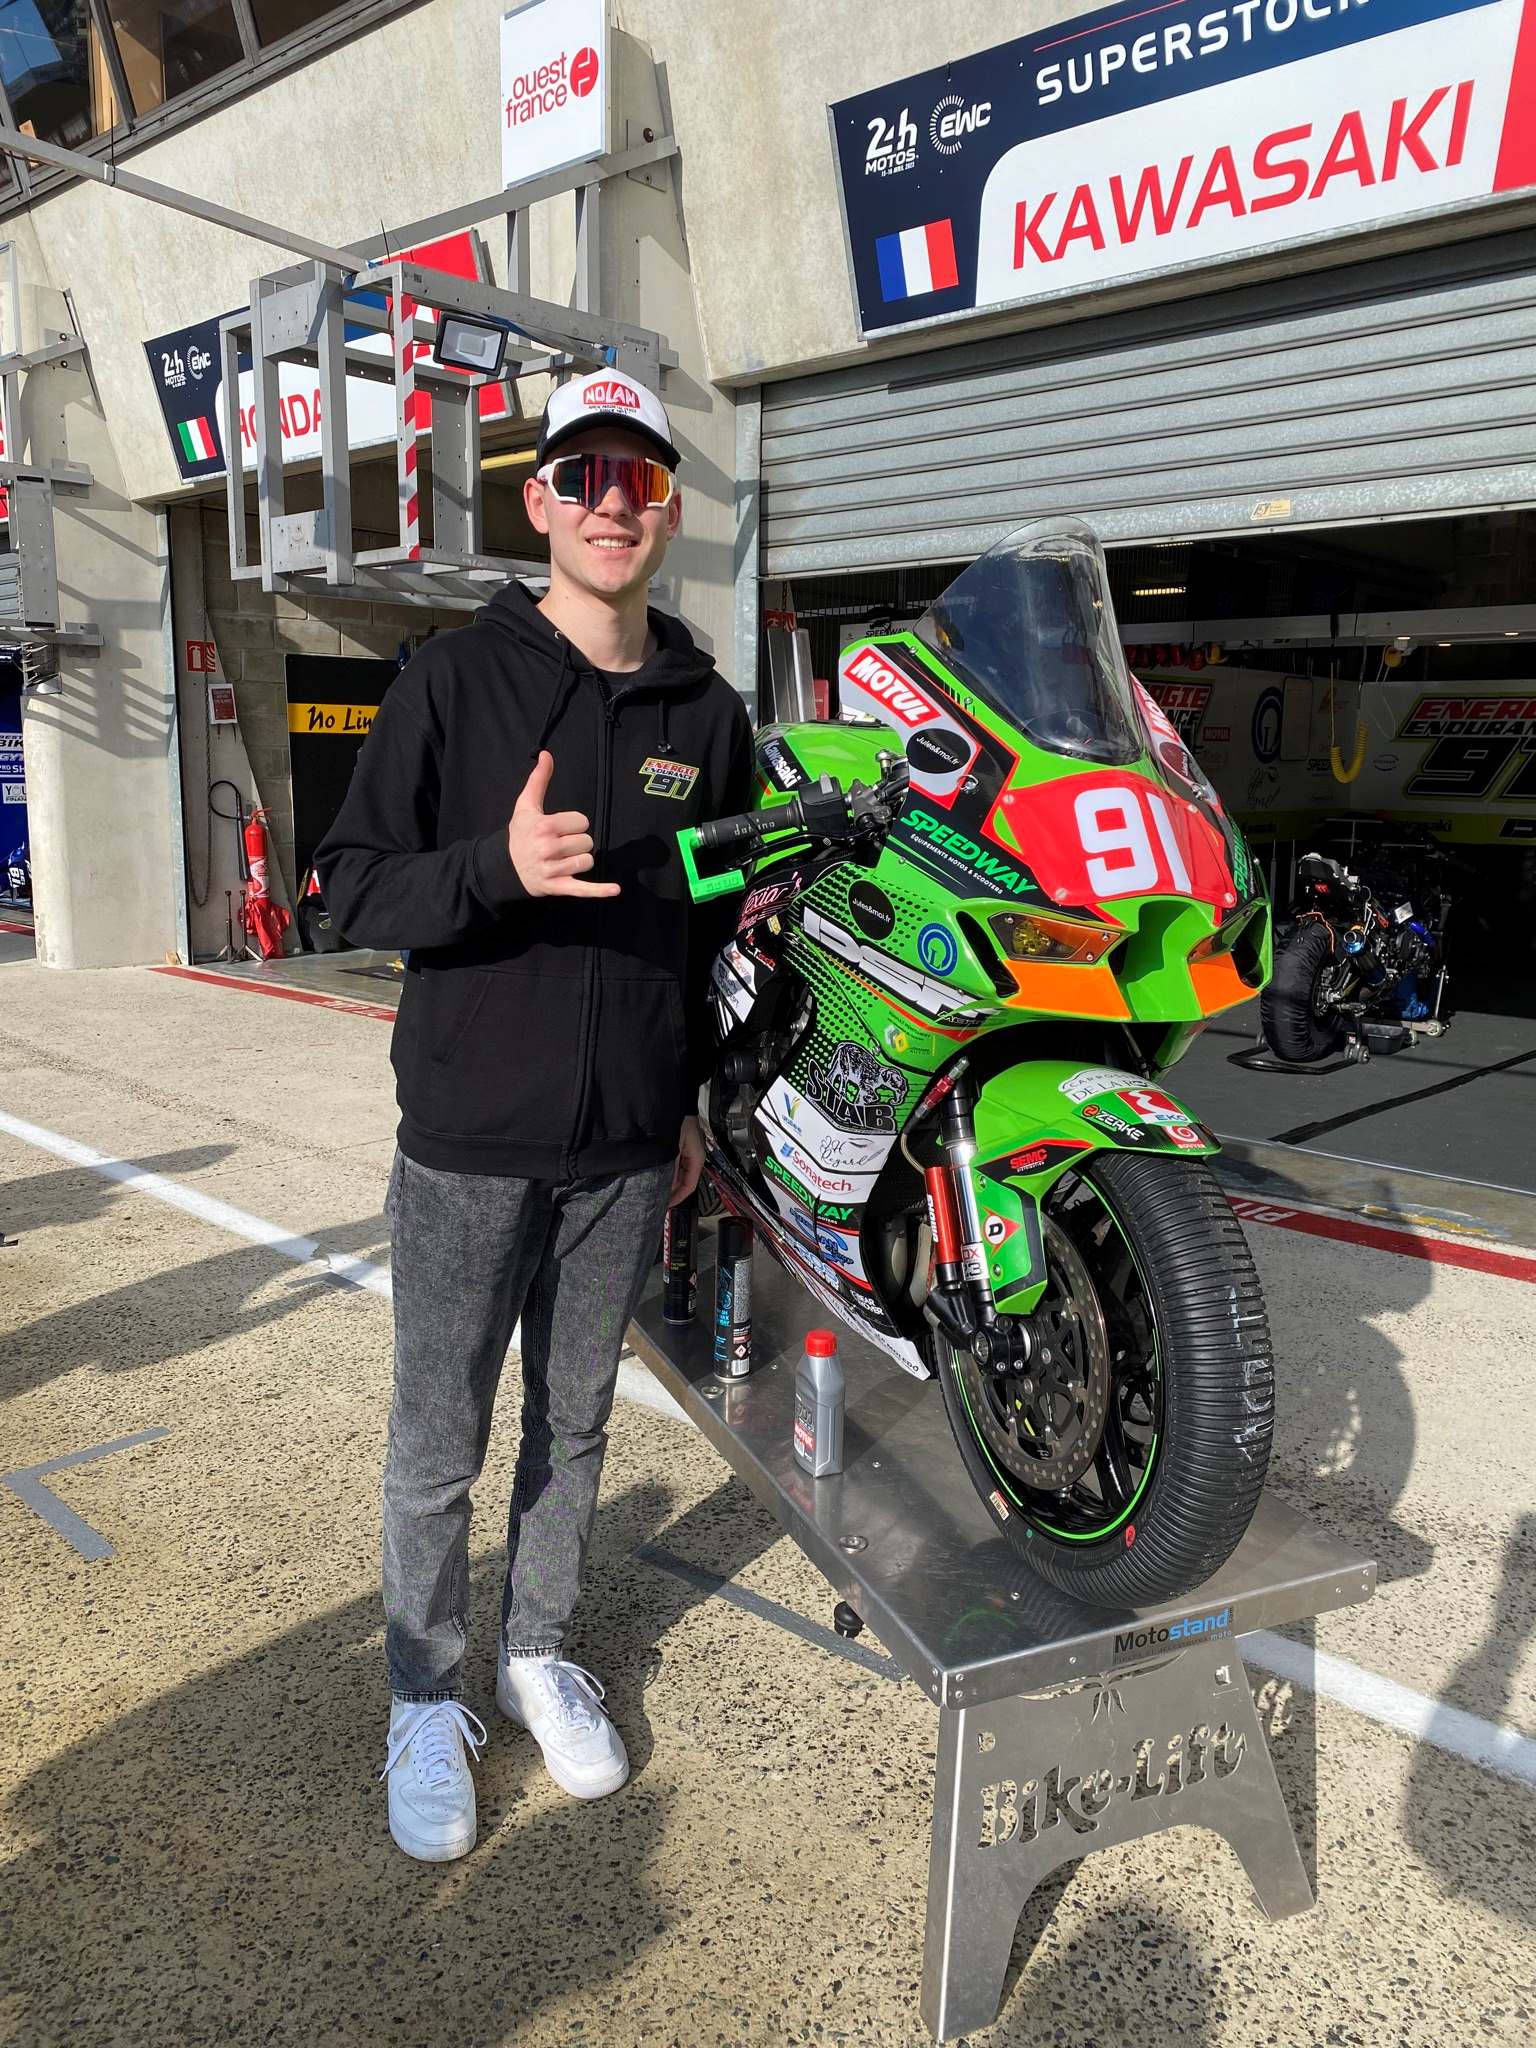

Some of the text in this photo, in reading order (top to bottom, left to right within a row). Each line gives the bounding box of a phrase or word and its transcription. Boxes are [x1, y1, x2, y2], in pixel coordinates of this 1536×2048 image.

[513, 51, 567, 100] ouest
[1036, 0, 1370, 105] SUPERSTOC
[505, 83, 567, 128] france
[940, 102, 992, 139] EWC
[866, 107, 918, 160] 24h
[865, 148, 916, 175] MOTOS
[1012, 79, 1476, 270] KAWASAKI
[585, 382, 637, 407] NOLAN
[851, 656, 931, 722] MOTUL
[307, 705, 336, 731] No
[762, 739, 802, 789] Kawasaki
[916, 736, 960, 766] Jules&moi.fr
[646, 774, 692, 799] 91
[900, 809, 1038, 895] SPEEDWAY
[910, 833, 949, 860] EQUIPEMENTS
[948, 856, 969, 873] MOTOS
[973, 872, 1004, 896] SCOOTERS
[1074, 786, 1192, 898] 91
[852, 898, 891, 923] Jules&moi.fr
[805, 1058, 897, 1132] STAB
[1072, 1087, 1097, 1101] DE
[1096, 1109, 1145, 1141] ZERKE
[1155, 1113, 1187, 1122] EKO
[792, 1150, 852, 1192] Sonatech
[1009, 1148, 1048, 1170] SEMC
[764, 1156, 855, 1221] SPEEDWAY
[1114, 1607, 1230, 1654] Motostand
[977, 1721, 1248, 1850] Bike-Lift
